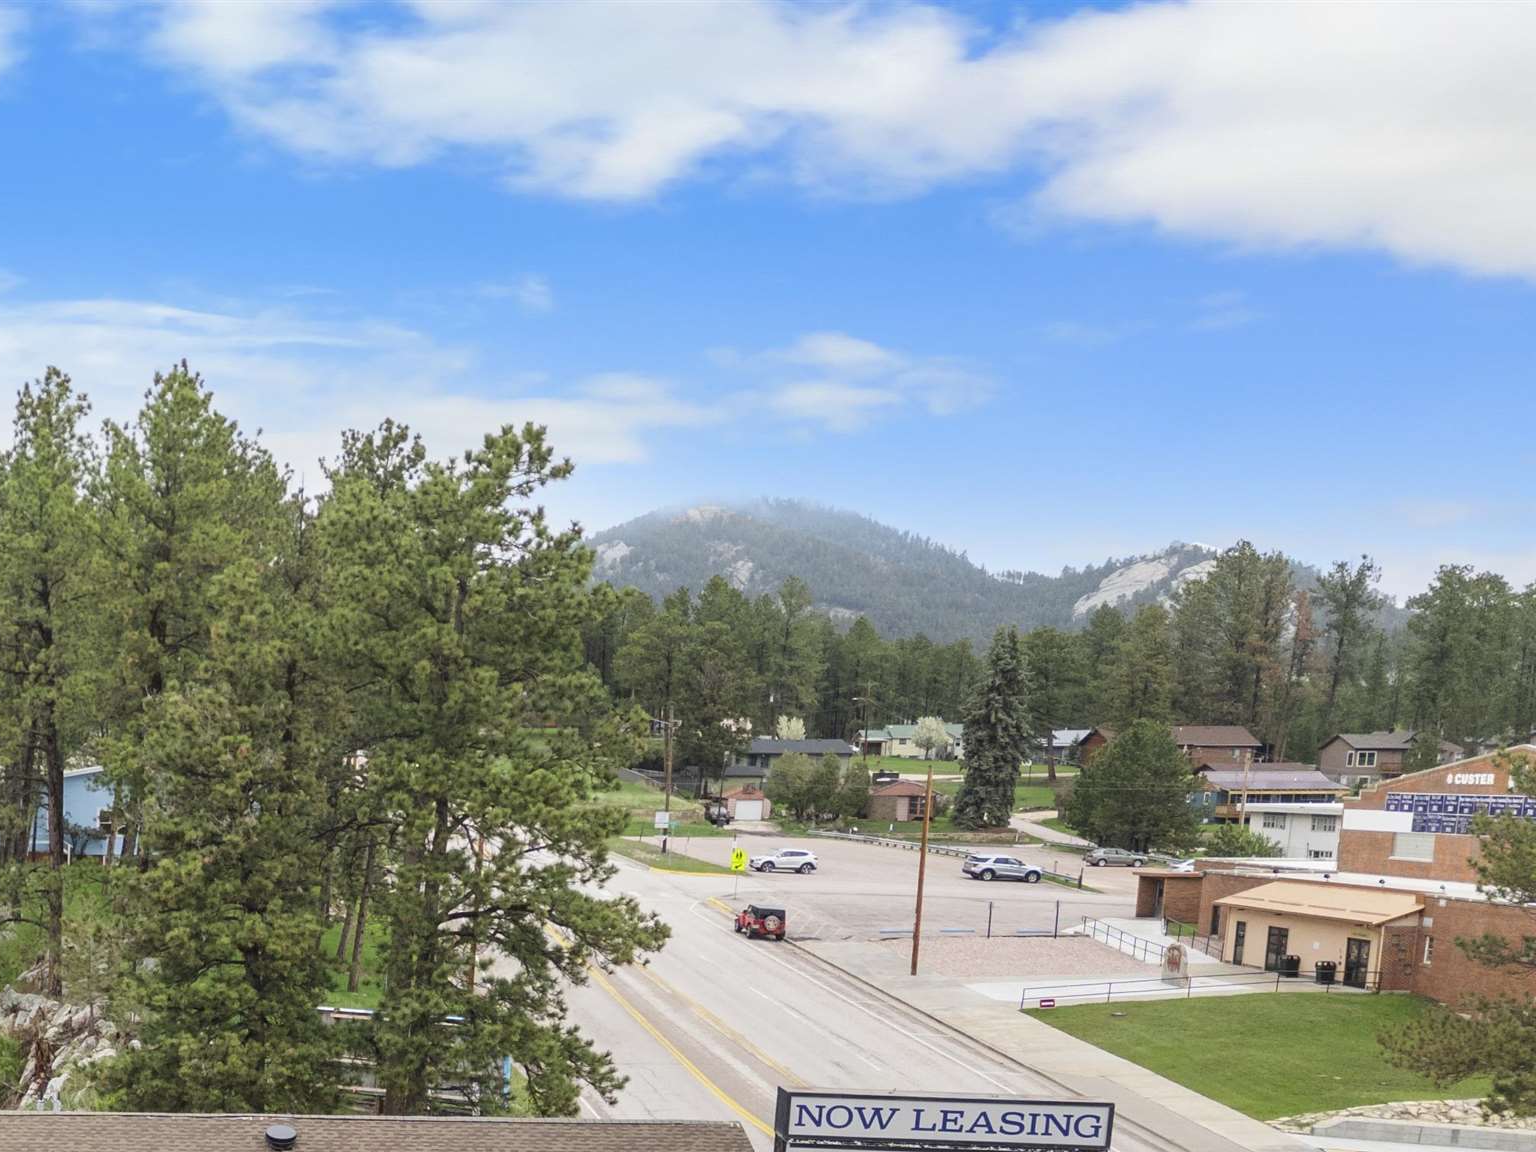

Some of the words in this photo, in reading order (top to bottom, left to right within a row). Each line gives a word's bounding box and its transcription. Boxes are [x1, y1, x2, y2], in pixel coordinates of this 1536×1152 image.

[1454, 773, 1495, 785] CUSTER
[794, 1104, 900, 1130] NOW
[910, 1108, 1102, 1139] LEASING
